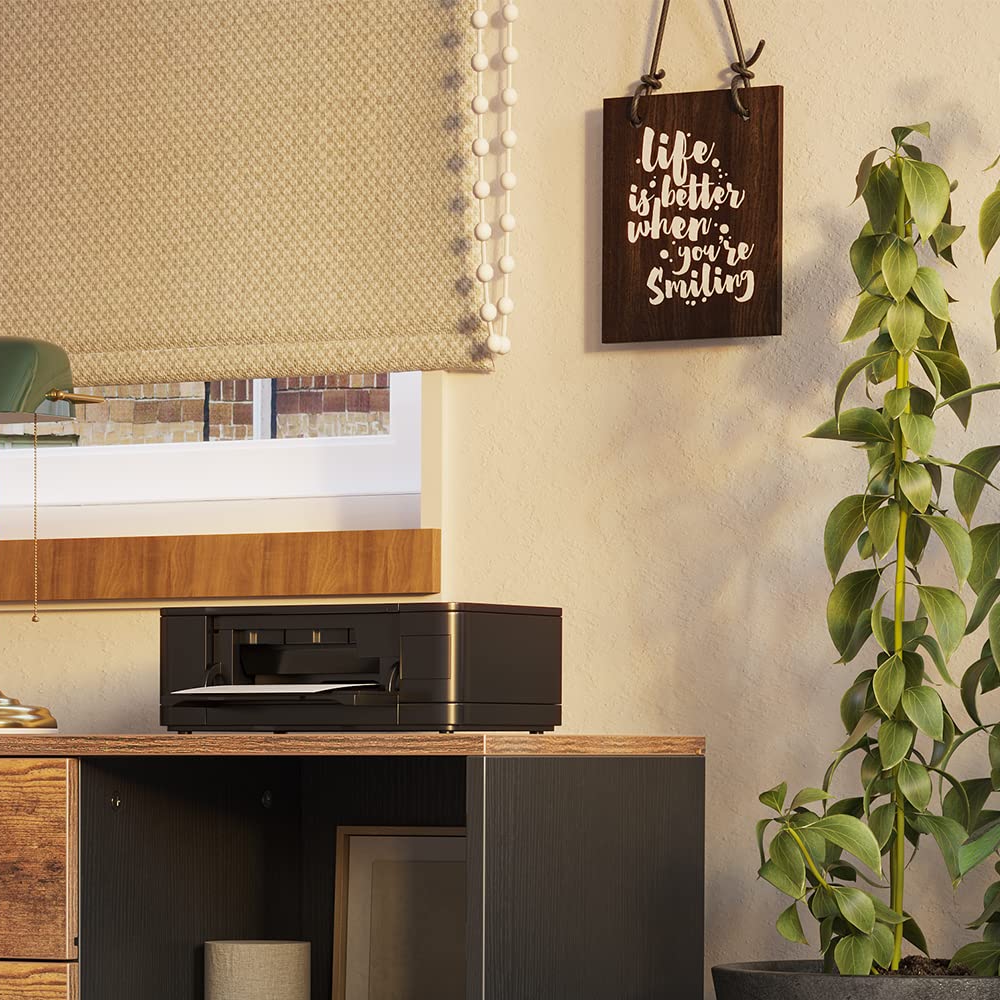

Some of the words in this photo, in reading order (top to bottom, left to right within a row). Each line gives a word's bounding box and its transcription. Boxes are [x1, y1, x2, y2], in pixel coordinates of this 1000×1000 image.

[629, 184, 655, 216] is
[661, 172, 746, 211] better
[627, 198, 712, 243] when
[671, 236, 755, 276] you're
[646, 263, 755, 306] Smiling
